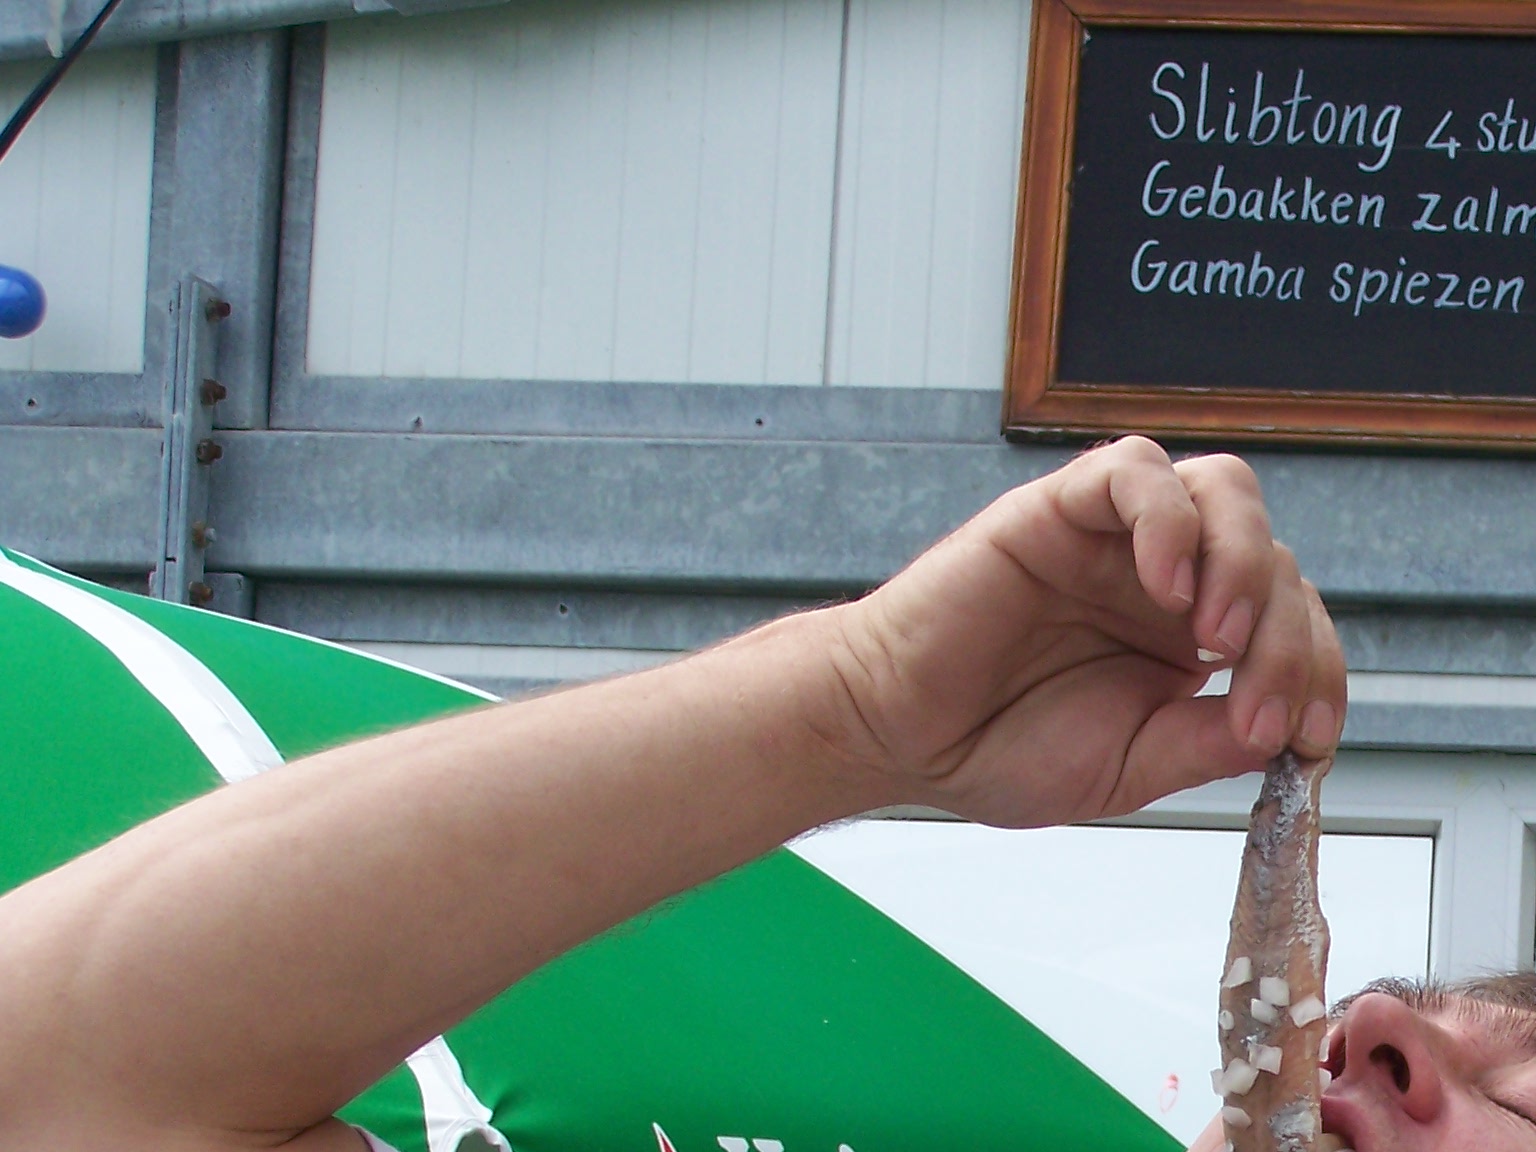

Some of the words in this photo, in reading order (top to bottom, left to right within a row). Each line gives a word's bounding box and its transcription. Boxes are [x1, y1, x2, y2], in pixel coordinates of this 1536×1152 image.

[1149, 62, 1402, 171] Slibtong
[1424, 111, 1461, 159] 4
[1141, 160, 1386, 228] Gebakken
[1131, 239, 1303, 300] Gamba
[1329, 256, 1525, 317] spiezen
